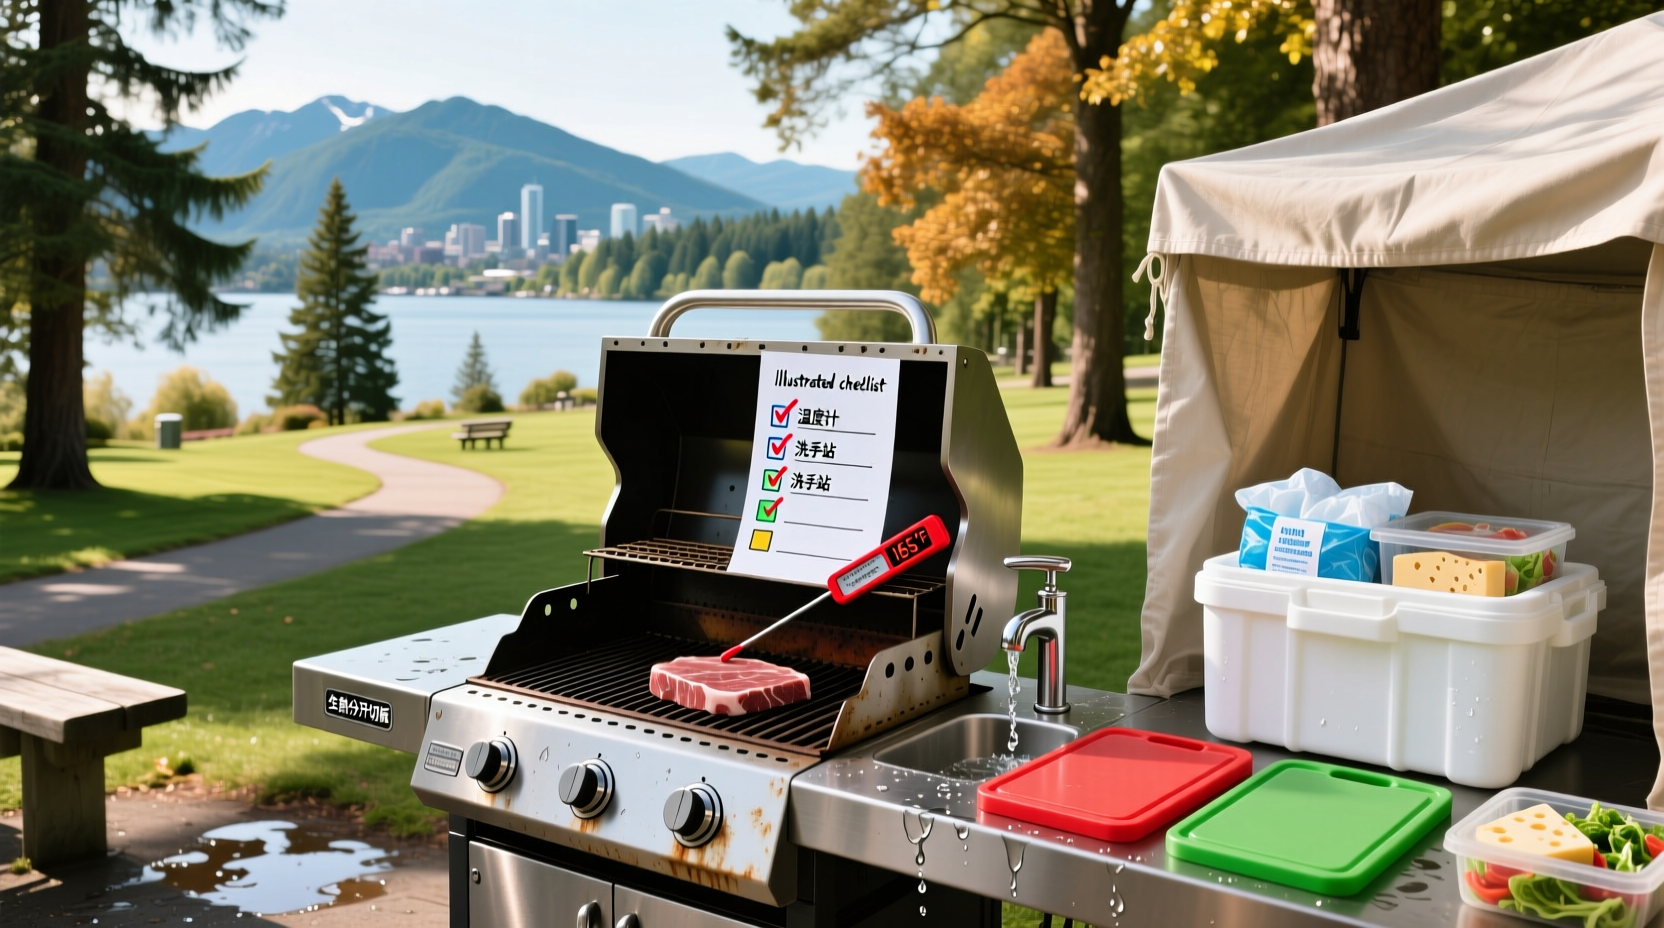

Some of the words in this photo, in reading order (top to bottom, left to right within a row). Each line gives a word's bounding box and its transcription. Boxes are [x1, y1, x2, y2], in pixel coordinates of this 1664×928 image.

[775, 369, 836, 389] Illustrated
[798, 408, 840, 427] 温度计
[795, 439, 836, 459] 洗手站
